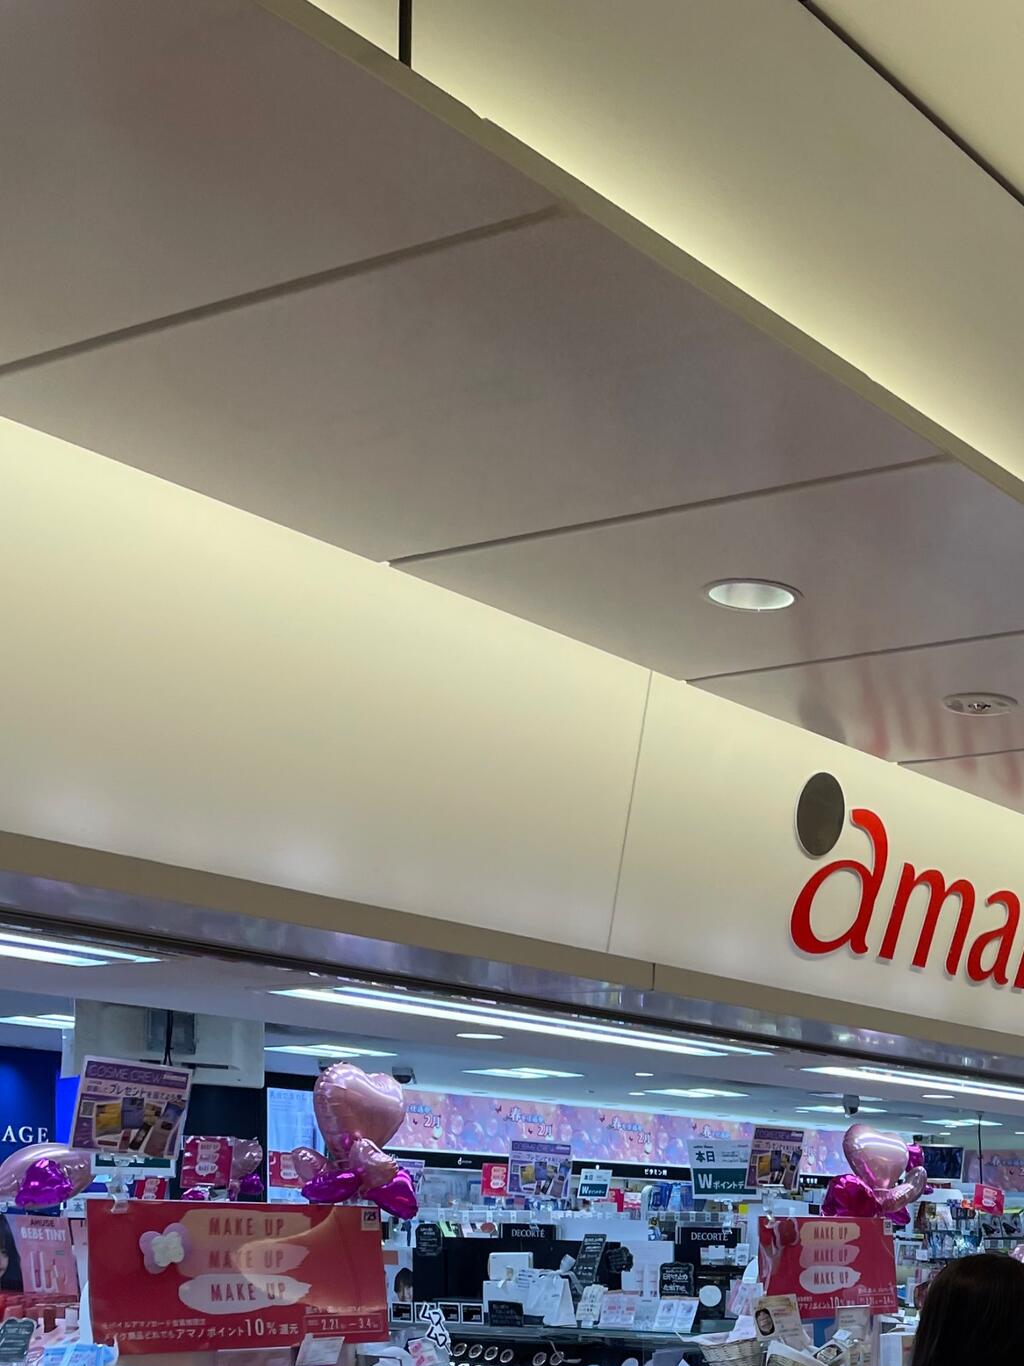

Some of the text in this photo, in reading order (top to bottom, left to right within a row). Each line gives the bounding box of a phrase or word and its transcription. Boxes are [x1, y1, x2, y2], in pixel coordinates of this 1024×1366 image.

[2, 1126, 49, 1143] AGE
[695, 1151, 715, 1163] 本日
[208, 1216, 284, 1236] MAKE UP
[264, 1249, 284, 1267] UP
[211, 1282, 286, 1301] MAKE UP
